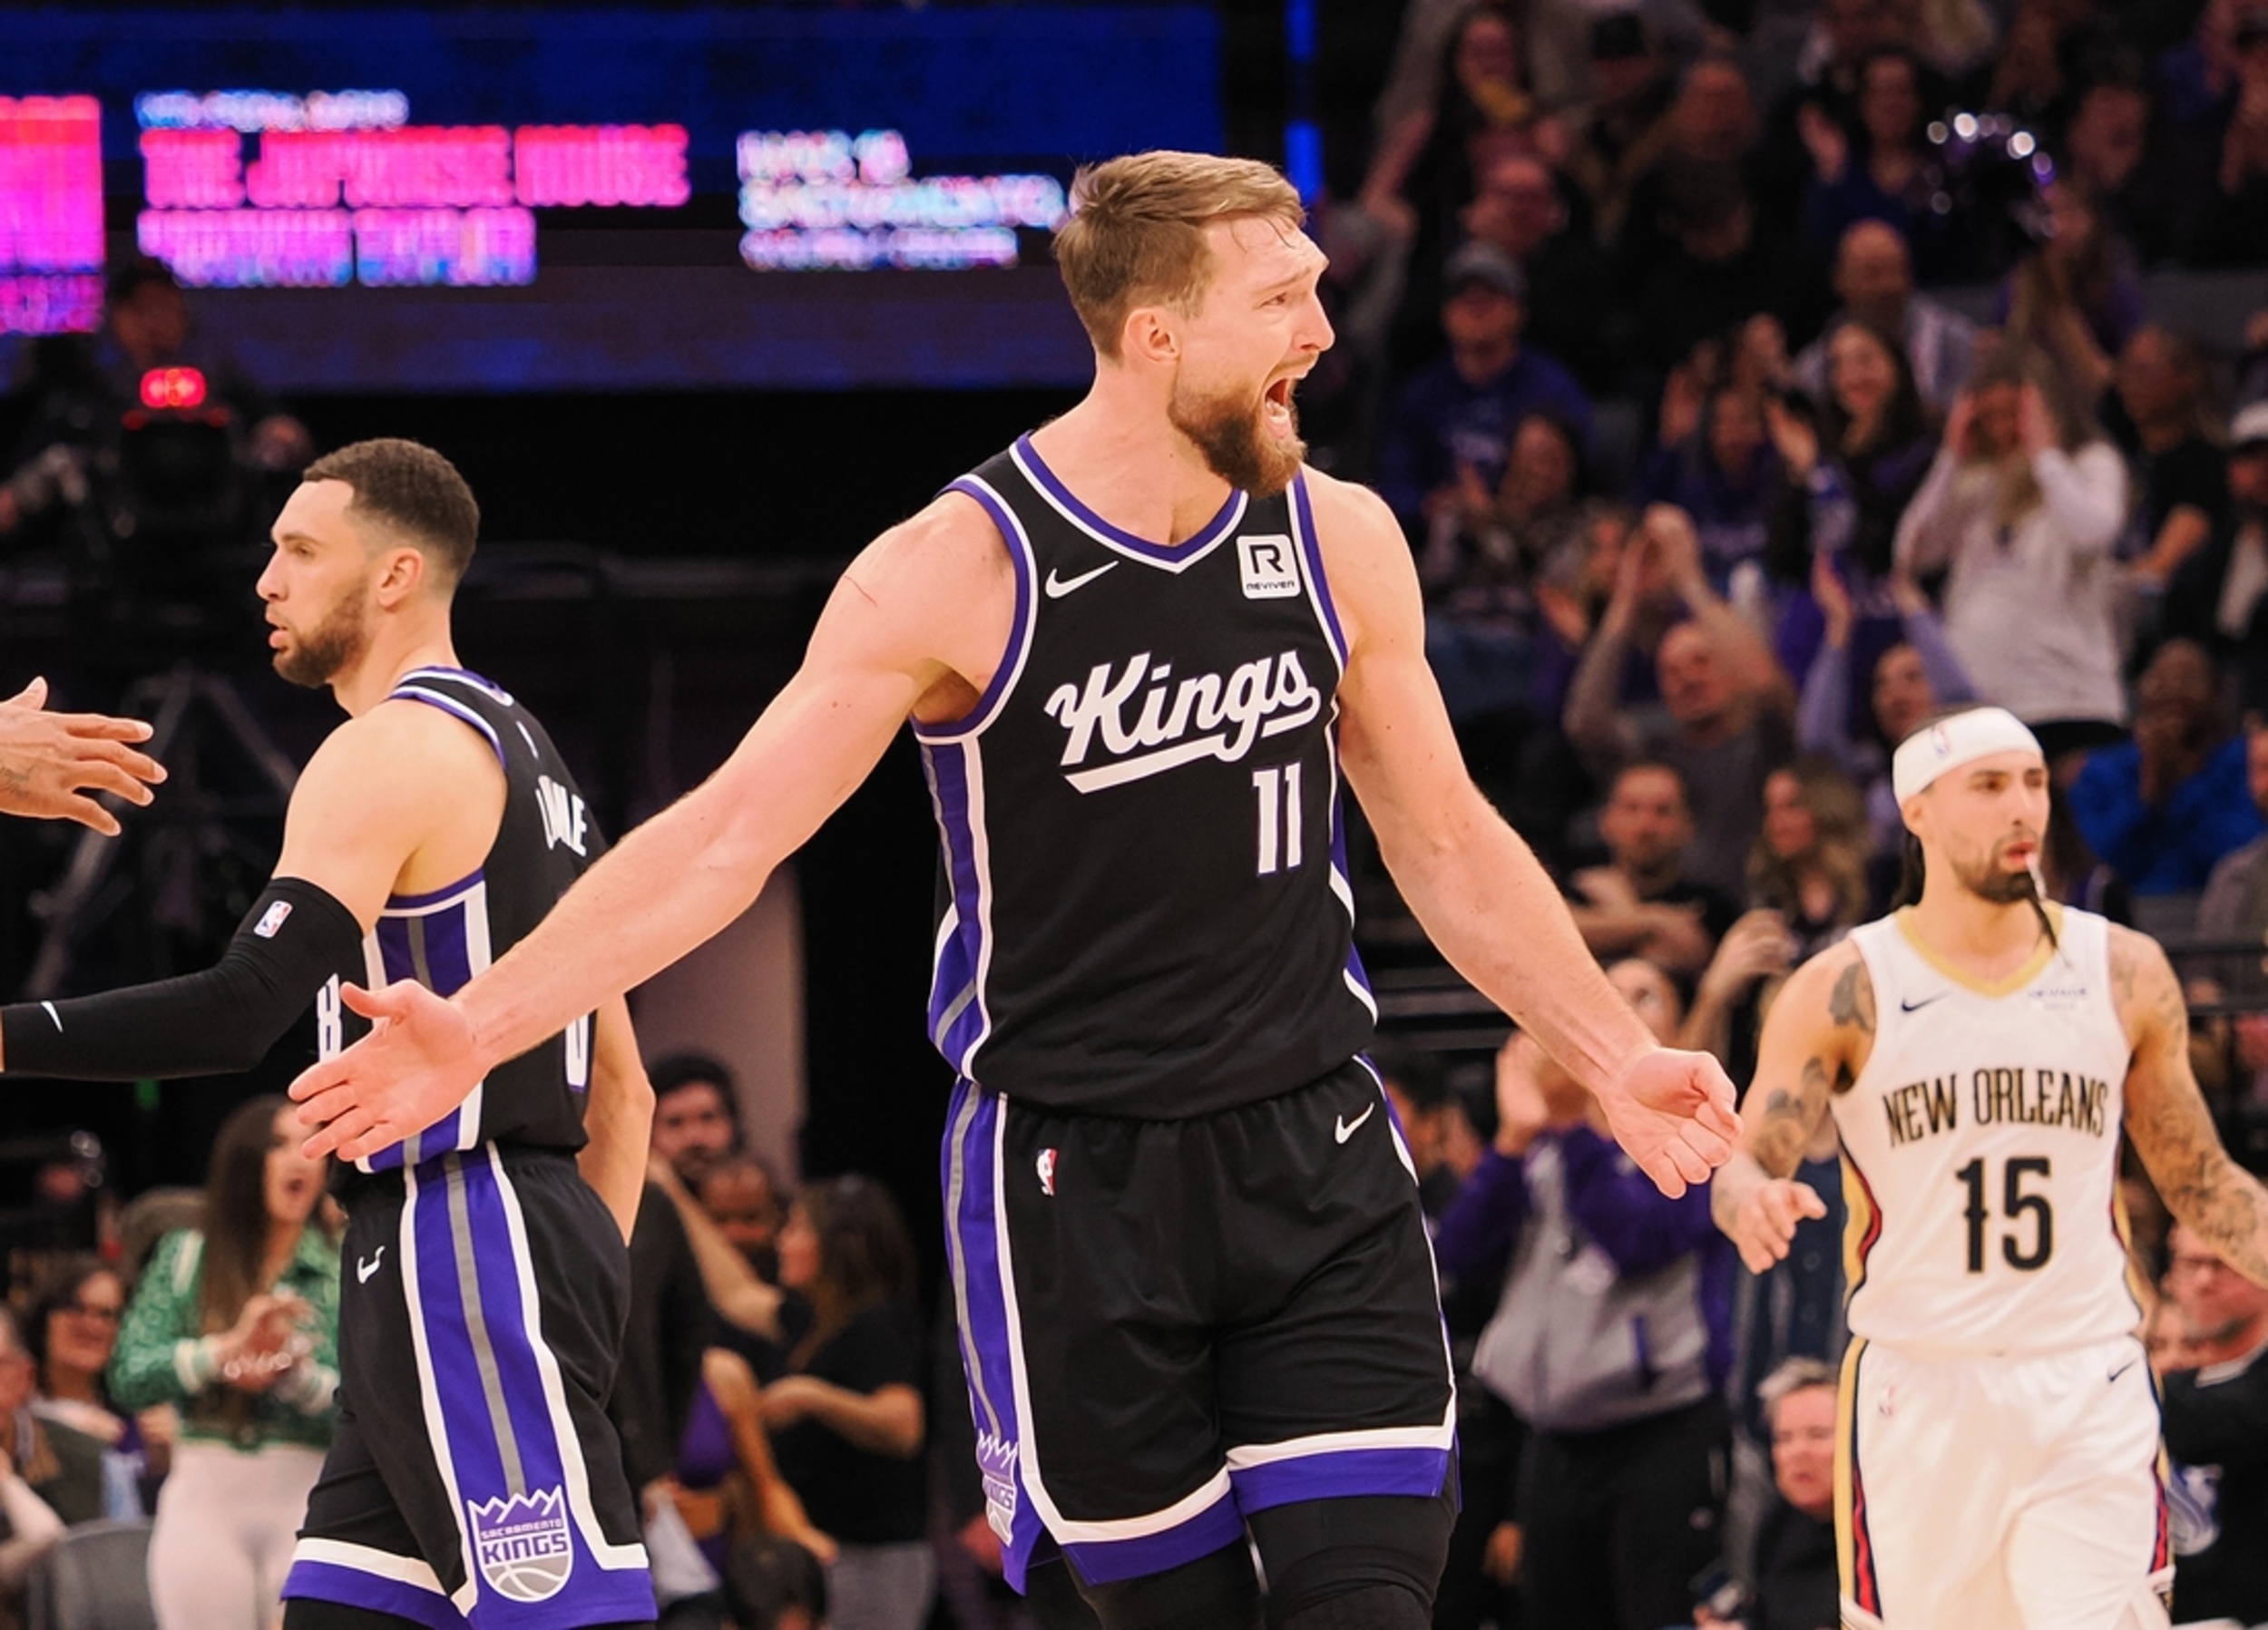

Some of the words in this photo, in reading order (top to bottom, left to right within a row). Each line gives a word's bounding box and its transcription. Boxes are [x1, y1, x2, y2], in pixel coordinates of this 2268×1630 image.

[1246, 581, 1295, 591] REVIVER
[1248, 544, 1285, 574] R
[1043, 649, 1322, 794] Kings
[1252, 761, 1303, 876] 11
[1882, 1072, 1957, 1148] NEW
[1972, 1067, 2109, 1139] ORLEANS
[1955, 1155, 2053, 1274] 15
[482, 1532, 569, 1565] KINGS
